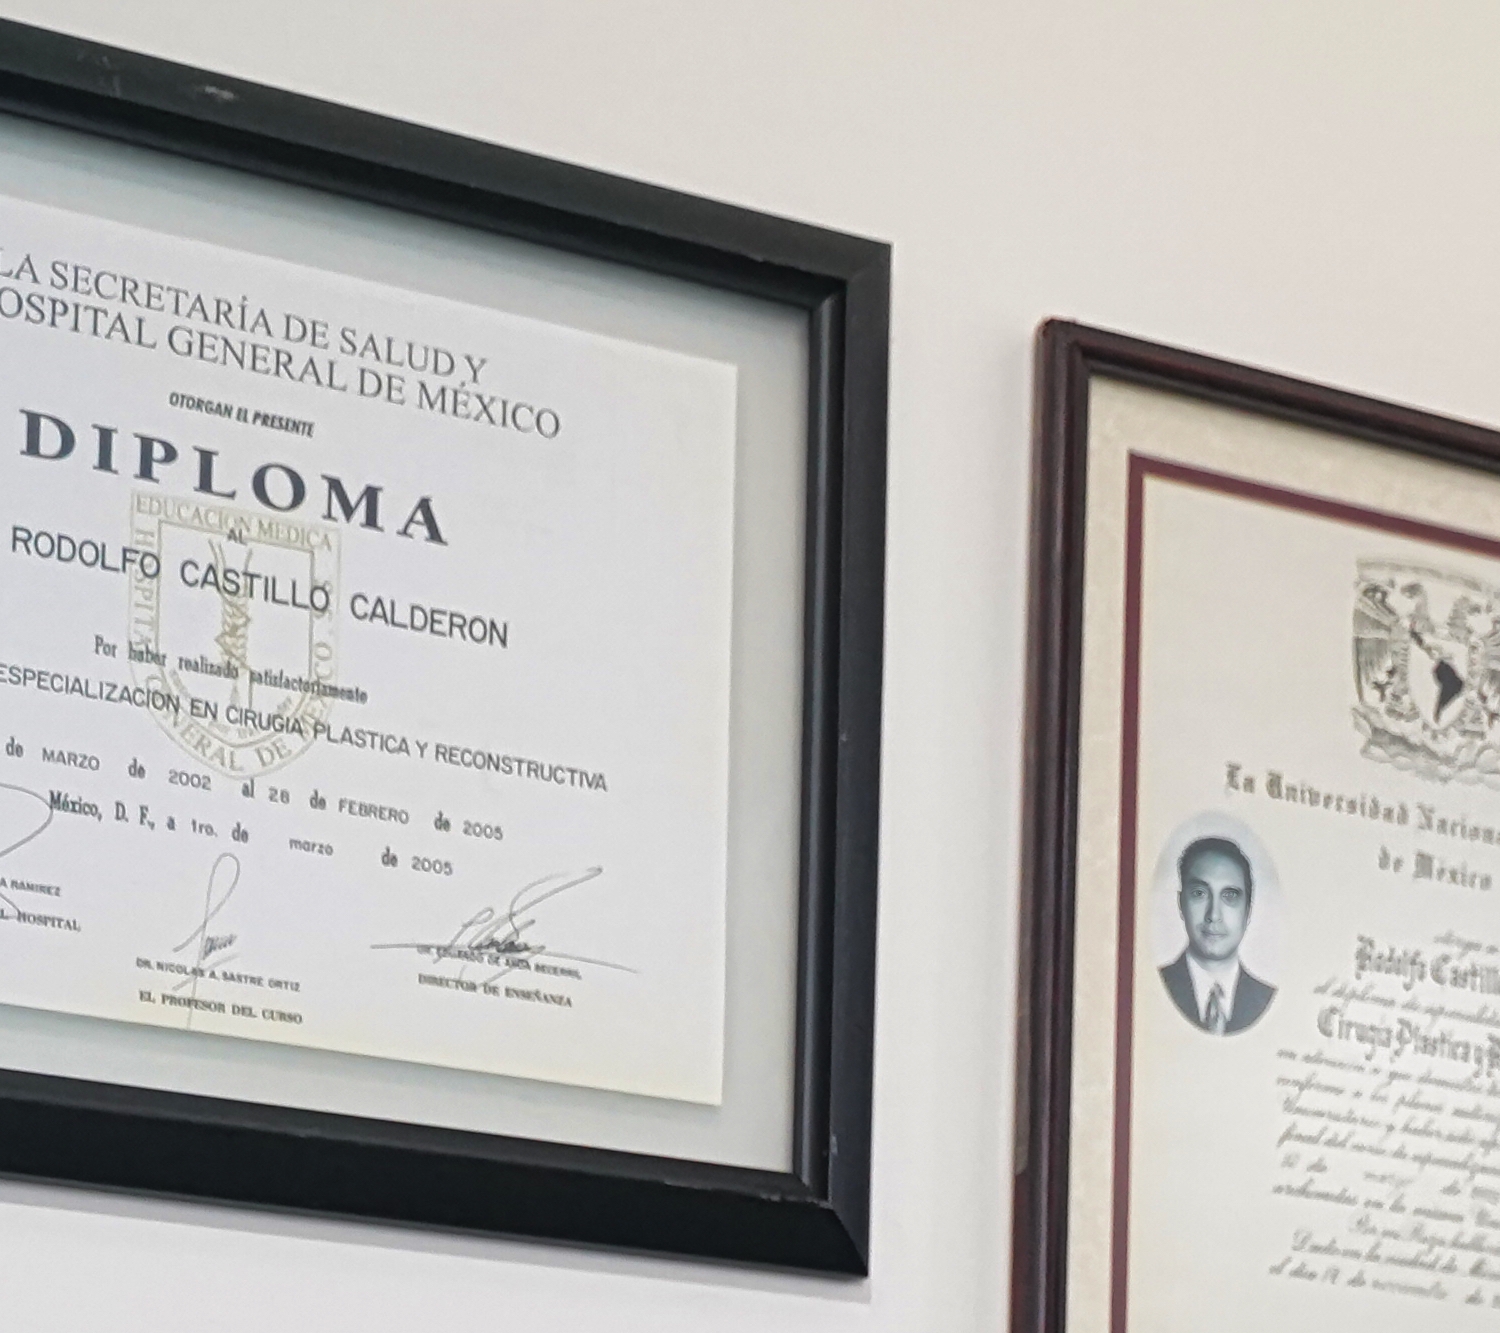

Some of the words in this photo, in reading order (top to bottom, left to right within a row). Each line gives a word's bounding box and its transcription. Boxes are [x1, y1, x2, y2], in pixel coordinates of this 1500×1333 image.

[49, 252, 273, 339] SECRETARÍA
[285, 313, 329, 352] DE
[340, 325, 455, 380] SALUD
[455, 351, 487, 387] Y
[167, 322, 347, 392] GENERAL
[358, 366, 408, 407] DE
[417, 371, 562, 441] MÉXICO
[169, 392, 231, 419] OTORGAN
[235, 407, 249, 423] EL
[252, 410, 314, 438] PRESENTE
[18, 407, 448, 546] DIPLOMA
[227, 527, 247, 545] AL
[12, 525, 161, 581] RODOLFO
[180, 558, 329, 614] CASTILLO
[350, 591, 509, 649] CALDERON
[94, 635, 117, 658] Por
[178, 650, 238, 680] realizado
[6, 734, 23, 758] de
[41, 747, 100, 771] MARZO
[128, 755, 145, 779] de
[168, 769, 211, 791] 2002
[241, 777, 254, 798] al
[309, 788, 325, 811] de
[338, 798, 408, 824] FEBRERO
[434, 810, 450, 832] de
[462, 820, 503, 841] 2005
[190, 696, 217, 720] EN
[225, 704, 303, 737] CIRUGIA
[313, 720, 410, 757] PLASTICA
[414, 739, 427, 759] Y
[435, 742, 607, 792] RECONSTRUCTIVA
[48, 789, 101, 822] México,
[115, 802, 128, 823] D.
[167, 817, 175, 831] a
[231, 821, 248, 844] de
[289, 837, 333, 857] marzo
[381, 847, 397, 868] de
[411, 856, 452, 876] 2005
[1265, 770, 1408, 826] Universidad
[17, 911, 80, 932] HOSPITAL
[139, 989, 155, 1003] EL
[161, 993, 226, 1013] PROFESOR
[231, 1003, 257, 1018] DEL
[261, 1007, 303, 1025] CURSO
